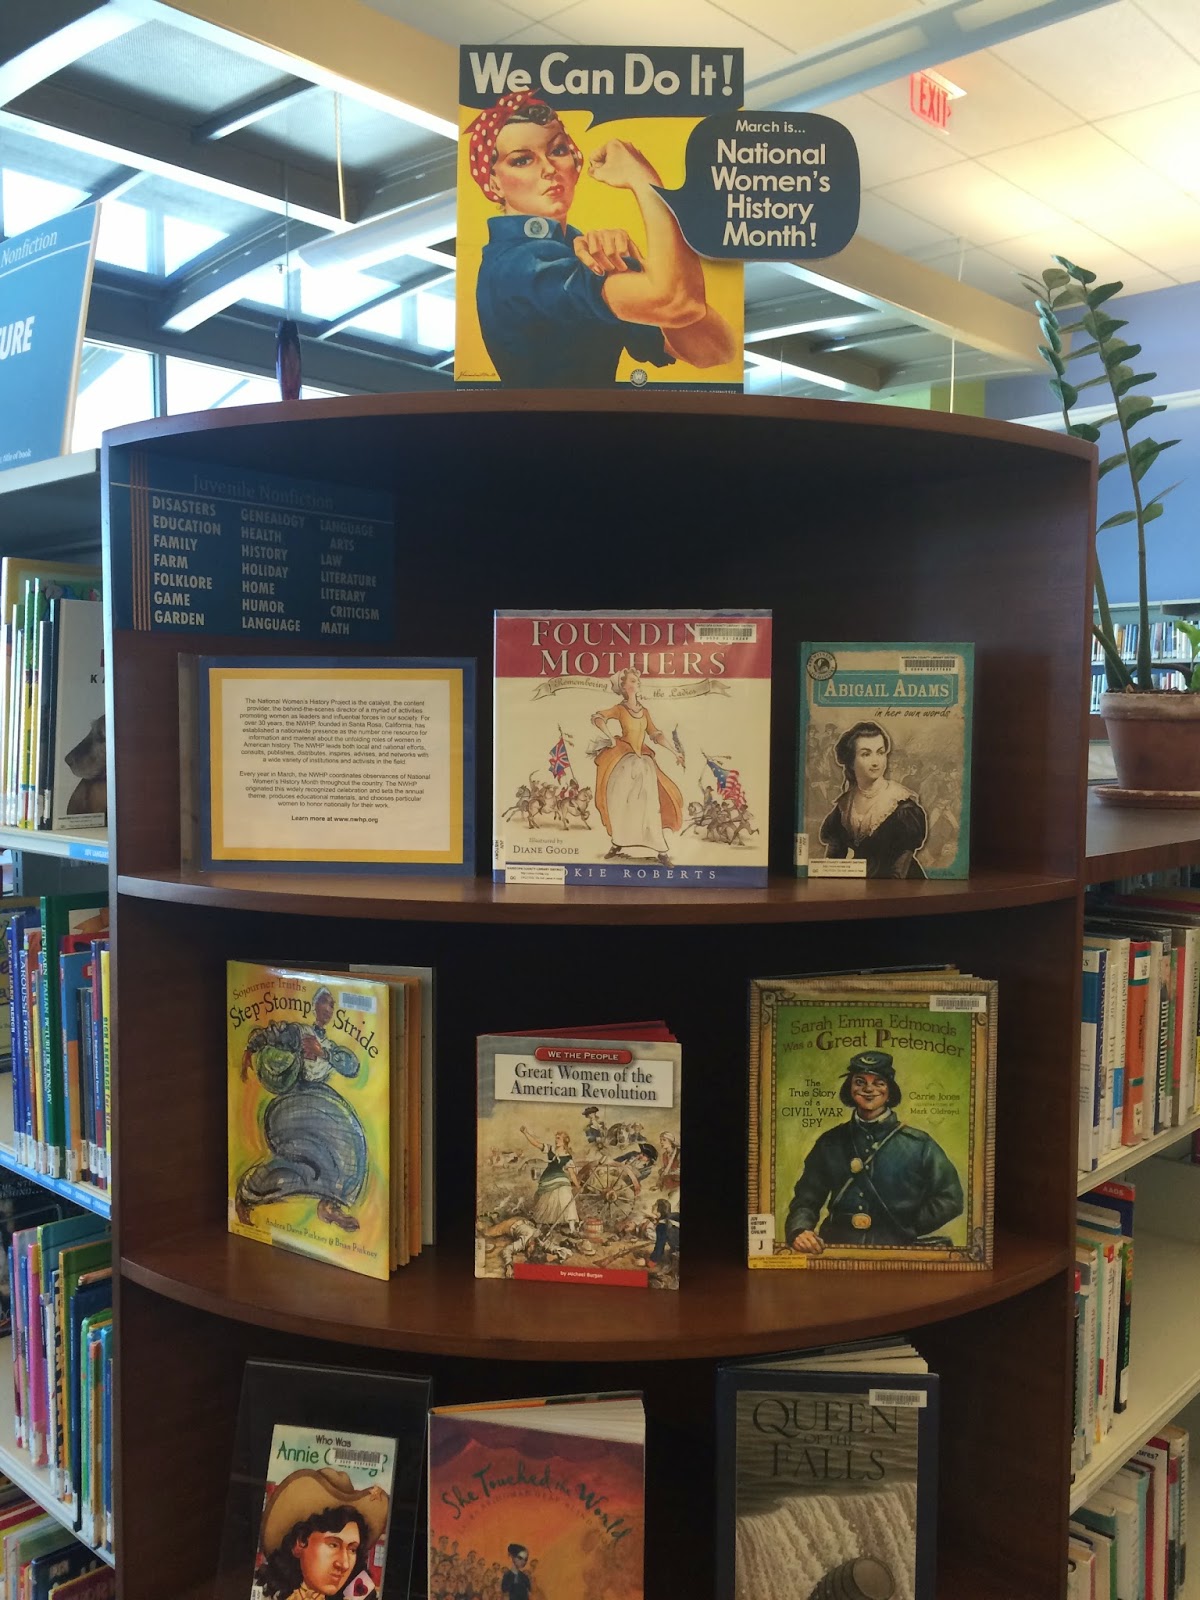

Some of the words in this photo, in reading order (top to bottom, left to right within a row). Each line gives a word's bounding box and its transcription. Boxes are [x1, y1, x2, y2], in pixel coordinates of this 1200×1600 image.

[469, 52, 532, 94] We
[540, 52, 614, 95] Can
[625, 53, 680, 95] Do
[690, 54, 734, 97] It!
[920, 77, 948, 128] EXIT
[736, 120, 780, 132] March
[783, 121, 806, 133] is...
[717, 138, 826, 165] National
[711, 166, 831, 192] Women's
[727, 193, 814, 225] History
[722, 221, 817, 247] Month!
[0, 231, 58, 267] Nonfiction
[0, 315, 35, 361] URE
[194, 475, 256, 497] Juvenile
[259, 486, 335, 511] Nonfiction
[152, 496, 216, 516] DISASTERS
[153, 515, 221, 536] EDUCATION
[241, 508, 305, 528] GENEALOGY
[241, 526, 282, 543] HEALTH
[320, 520, 374, 537] LANGUAGE
[154, 534, 198, 551] FAMILY
[330, 538, 355, 552] ARTS
[241, 544, 288, 561] HISTORY
[320, 554, 343, 567] LAW
[154, 554, 188, 569] FARM
[242, 562, 289, 579] HOLIDAY
[320, 571, 377, 587] LITERATURE
[154, 572, 213, 590] FOLKLORE
[242, 580, 275, 595] HOME
[154, 591, 190, 606] GAME
[320, 588, 366, 602] LITERARY
[242, 598, 285, 614] HUMOR
[330, 605, 380, 621] CRITICISM
[154, 610, 205, 626] GARDEN
[242, 616, 301, 632] LANGUAGE
[321, 622, 350, 635] MATH
[531, 620, 733, 647] FOUNDIN
[539, 649, 726, 676] MOTHERS
[554, 678, 608, 692] Remembering
[653, 689, 665, 698] the
[670, 689, 698, 699] Ladies
[824, 678, 889, 697] ABIGAIL
[893, 678, 949, 697] ADAMS
[875, 708, 882, 717] in
[885, 706, 901, 717] her
[923, 706, 951, 717] words
[513, 846, 543, 854] DIANE
[546, 845, 579, 854] GOODE
[529, 837, 556, 845] Illustrated
[557, 838, 563, 846] by
[623, 869, 716, 880] ROBERTS
[20, 950, 28, 1016] LAROUSSE
[232, 980, 275, 1000] Sojourner
[229, 991, 312, 1029] Step-Stomp
[332, 1009, 379, 1059] Stride
[790, 1016, 832, 1035] Sarah
[838, 1014, 883, 1029] Emma
[889, 1014, 957, 1037] Edmonds
[783, 1041, 804, 1052] Was
[806, 1041, 813, 1049] a
[816, 1030, 868, 1051] Great
[875, 1028, 966, 1058] Pretender
[584, 1052, 618, 1061] PEOPLE
[515, 1062, 553, 1079] Great
[557, 1065, 609, 1082] Women
[613, 1066, 629, 1083] of
[631, 1067, 653, 1084] the
[510, 1080, 576, 1098] American
[581, 1082, 656, 1101] Revolution
[805, 1079, 821, 1087] The
[788, 1087, 810, 1097] True
[812, 1087, 836, 1099] Story
[908, 1092, 935, 1101] Carrie
[938, 1092, 961, 1101] Jones
[804, 1099, 813, 1107] of
[910, 1107, 927, 1115] Mark
[781, 1107, 813, 1117] CIVIL
[818, 1107, 844, 1117] WAR
[801, 1118, 823, 1128] SPY
[758, 1240, 763, 1250] J
[752, 1398, 898, 1438] QUEEN
[316, 1434, 333, 1446] Who
[335, 1437, 352, 1448] Was
[277, 1441, 320, 1464] Annie
[771, 1442, 885, 1481] FALLS
[441, 1485, 480, 1520] She
[472, 1460, 552, 1498] Touched
[577, 1483, 633, 1544] World
